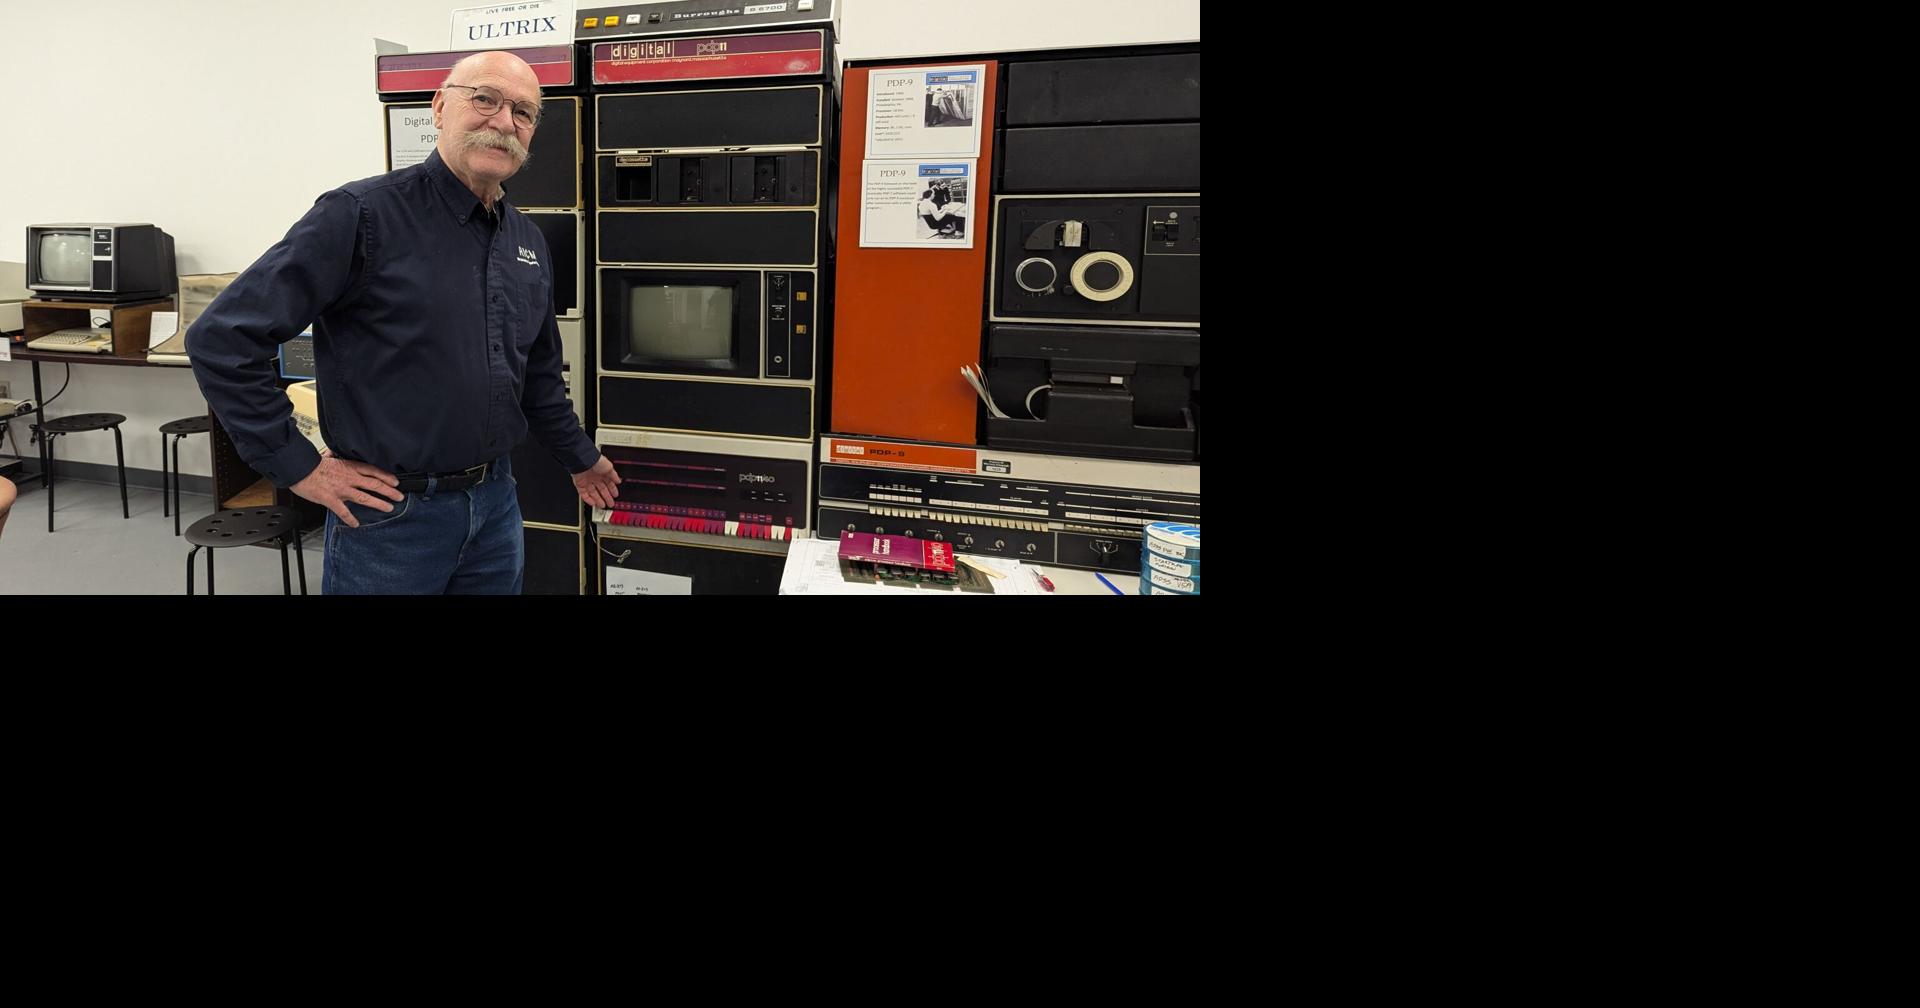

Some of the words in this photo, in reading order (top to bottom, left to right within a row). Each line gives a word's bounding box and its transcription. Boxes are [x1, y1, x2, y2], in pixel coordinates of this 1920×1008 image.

[468, 16, 556, 41] ULTRIX
[612, 42, 672, 58] digital
[887, 78, 914, 87] PDP-9
[404, 117, 433, 128] Digital
[880, 169, 906, 178] PDP-9
